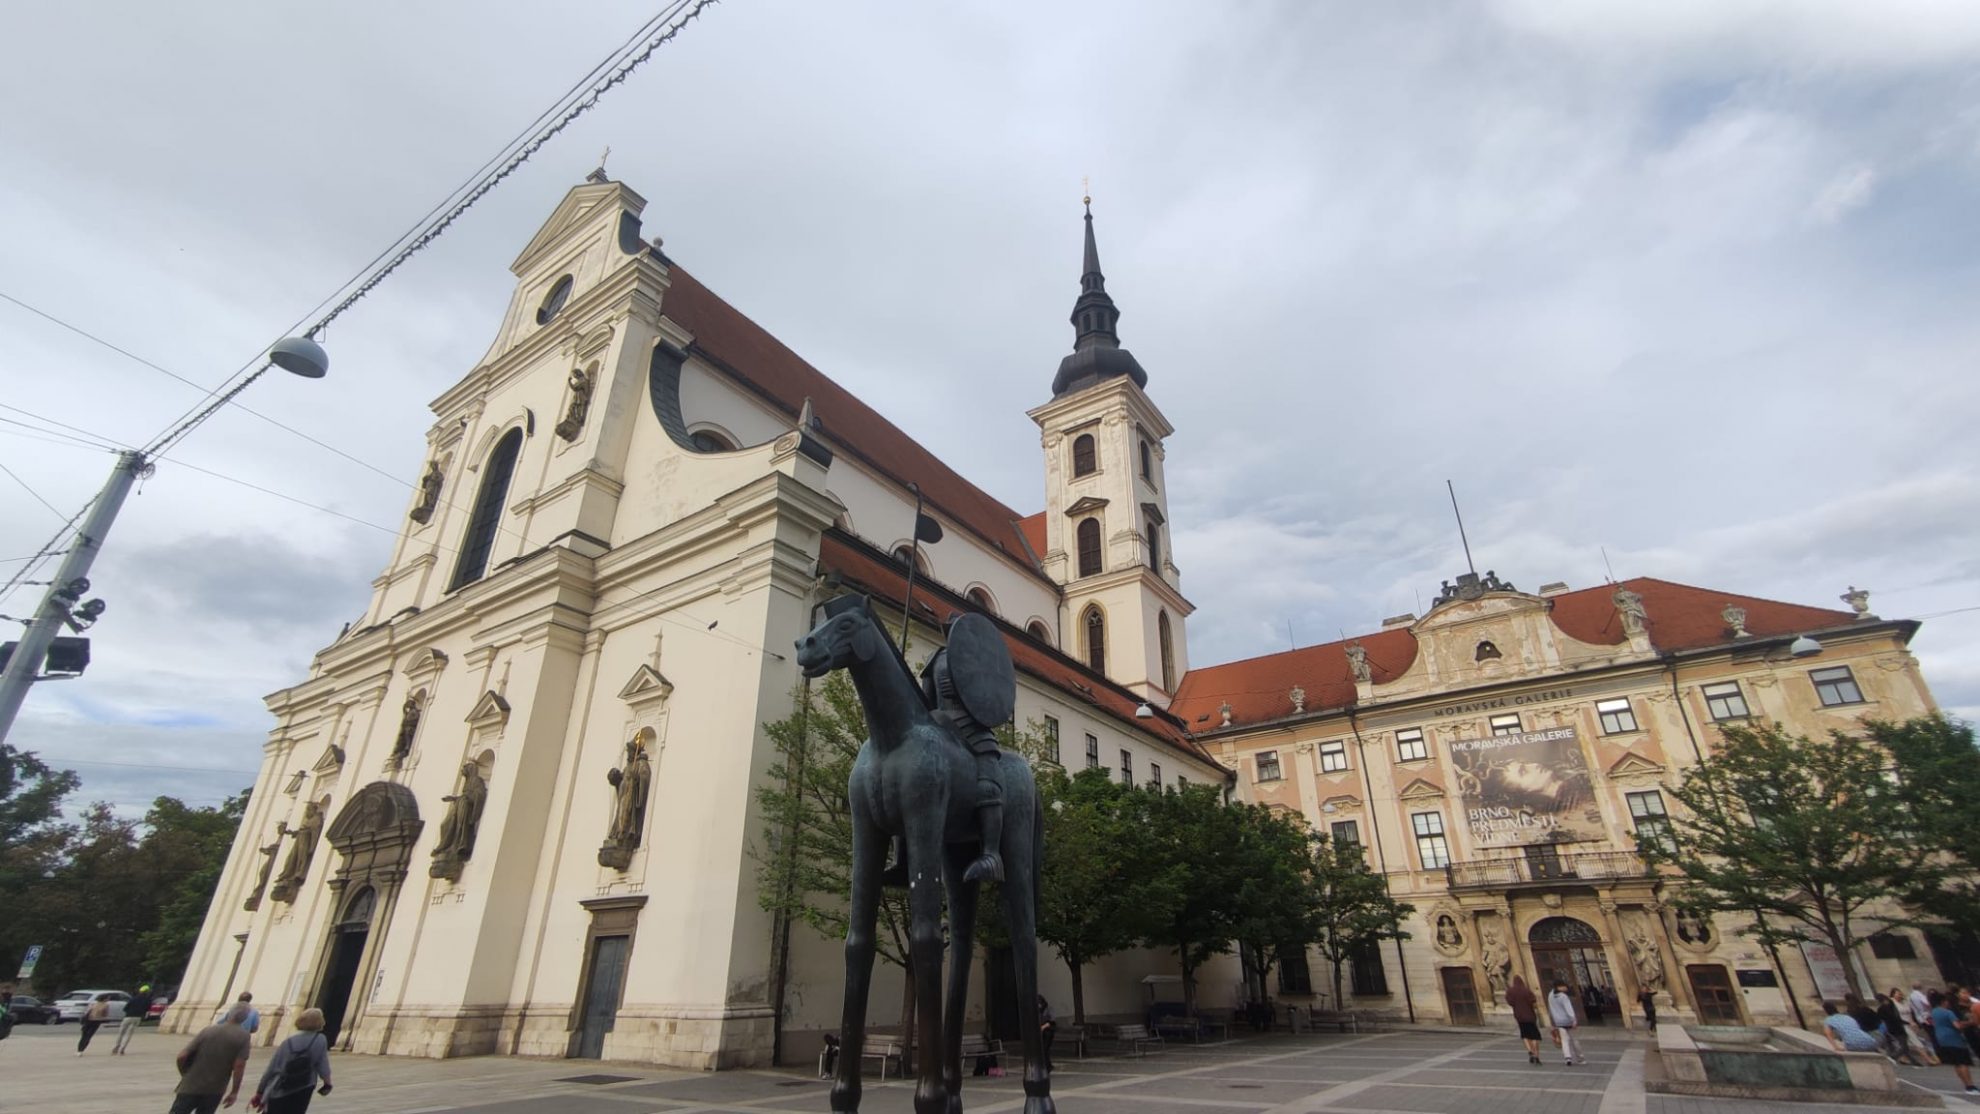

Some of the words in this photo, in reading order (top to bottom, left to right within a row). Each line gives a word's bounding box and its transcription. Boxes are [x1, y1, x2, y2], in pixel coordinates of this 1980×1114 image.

[1515, 689, 1573, 705] GALERIE
[1523, 728, 1575, 744] GALERIE
[1469, 806, 1509, 820] BRNO
